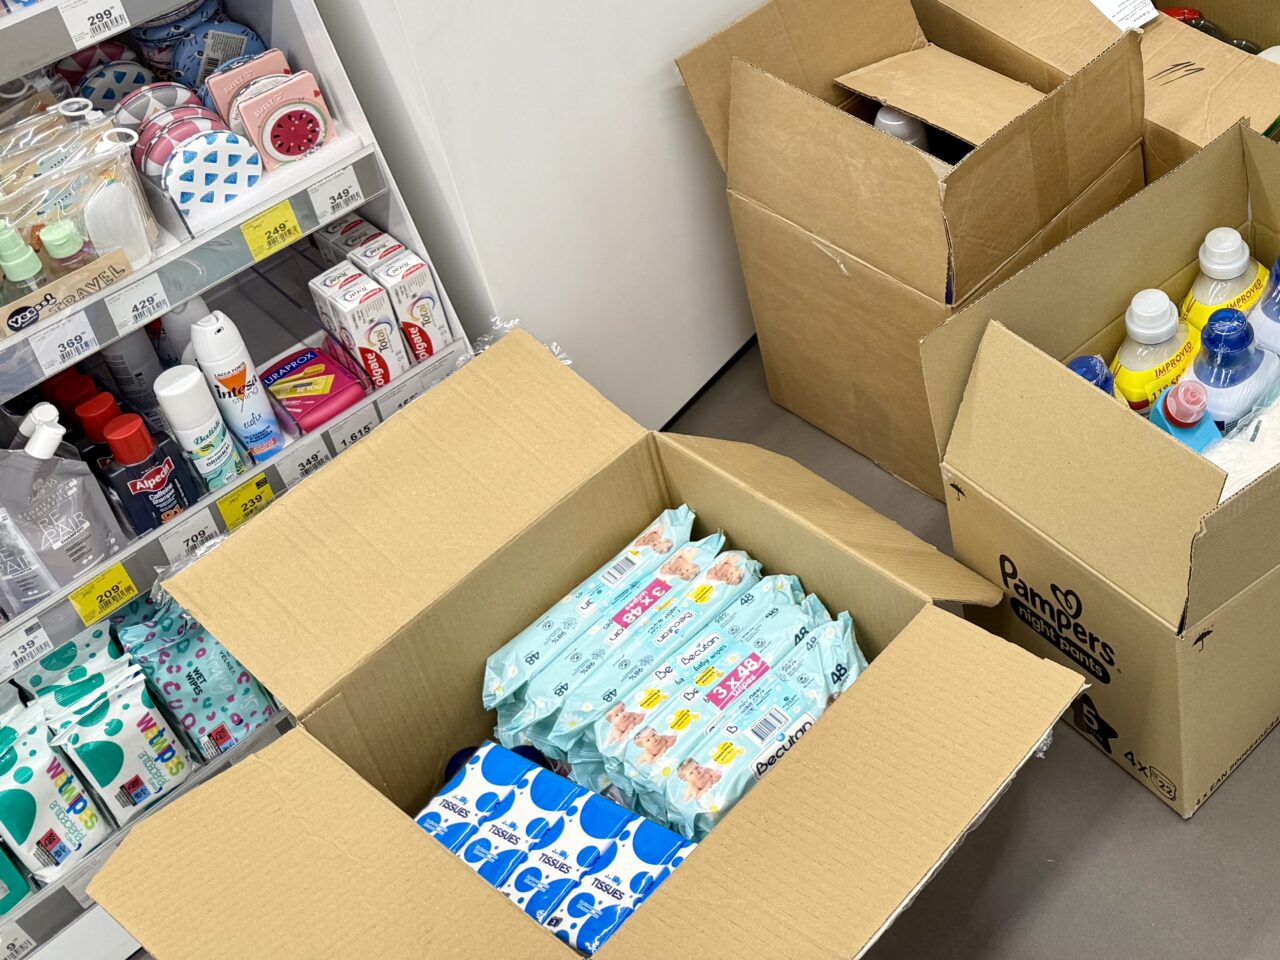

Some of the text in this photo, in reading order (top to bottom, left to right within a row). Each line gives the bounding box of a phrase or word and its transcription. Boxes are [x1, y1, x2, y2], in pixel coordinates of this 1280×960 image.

[87, 7, 114, 27] 299
[328, 188, 351, 205] 349
[264, 222, 288, 240] 249
[49, 264, 126, 313] TRAVEL
[1226, 278, 1263, 310] IMPROVED
[131, 296, 156, 314] 429
[416, 304, 433, 329] Total
[57, 334, 84, 354] 369
[374, 327, 389, 354] Total
[1154, 341, 1193, 378] IMPROVED
[340, 424, 372, 448] 1.615
[297, 453, 320, 472] 349
[240, 494, 264, 513] 239
[183, 529, 207, 546] 709
[95, 584, 121, 604] 209
[740, 592, 755, 607] 48
[622, 607, 643, 624] 48
[999, 553, 1116, 667] Pampers
[10, 638, 36, 657] 139
[680, 634, 720, 666] Becutan
[1019, 606, 1103, 677] night pants
[524, 650, 541, 666] 48
[185, 671, 204, 696] WIPES
[192, 667, 208, 685] WET
[713, 657, 759, 699] 3 48
[830, 663, 848, 686] 48
[554, 682, 571, 697] 48
[602, 688, 618, 703] 48
[1082, 703, 1099, 731] 5
[136, 712, 185, 777] wetwipes
[755, 720, 813, 777] Becutan
[1124, 750, 1174, 797] 4x 22
[46, 756, 99, 831] wetwipes
[439, 798, 471, 819] TISSUES
[488, 824, 521, 846] TISSUES
[538, 852, 573, 875] TISSUES
[590, 877, 626, 901] TISSUES
